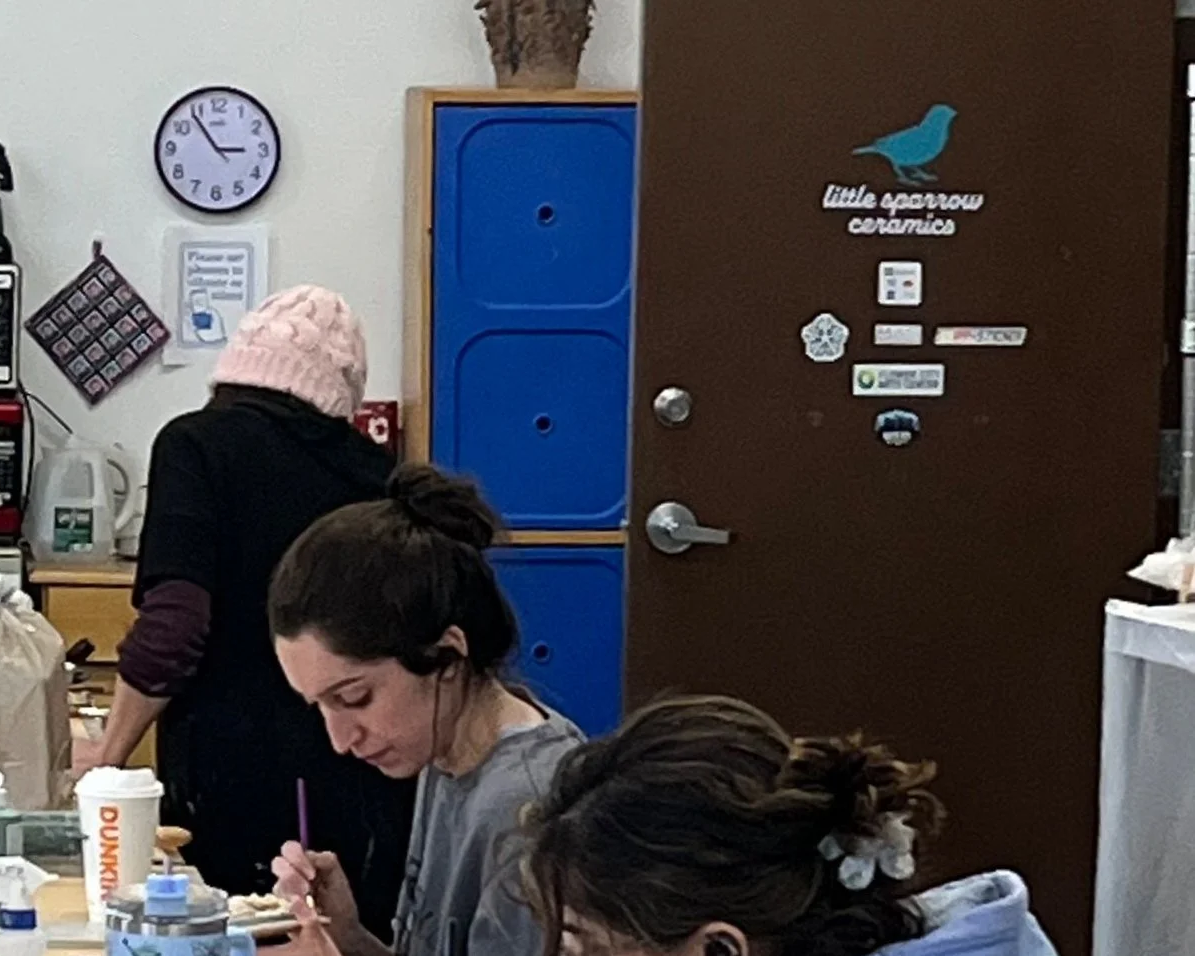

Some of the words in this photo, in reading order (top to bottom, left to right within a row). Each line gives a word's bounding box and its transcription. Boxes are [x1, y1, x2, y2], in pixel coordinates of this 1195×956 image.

[210, 98, 228, 114] 12
[173, 120, 192, 136] 10
[251, 119, 263, 136] 2
[165, 140, 177, 157] 9
[258, 142, 270, 158] 3
[172, 163, 184, 180] 8
[249, 165, 262, 180] 4
[190, 179, 202, 195] 7
[210, 185, 223, 202] 6
[232, 180, 244, 197] 5
[822, 183, 877, 209] little
[880, 192, 984, 216] sparrow
[848, 211, 956, 235] ceramics
